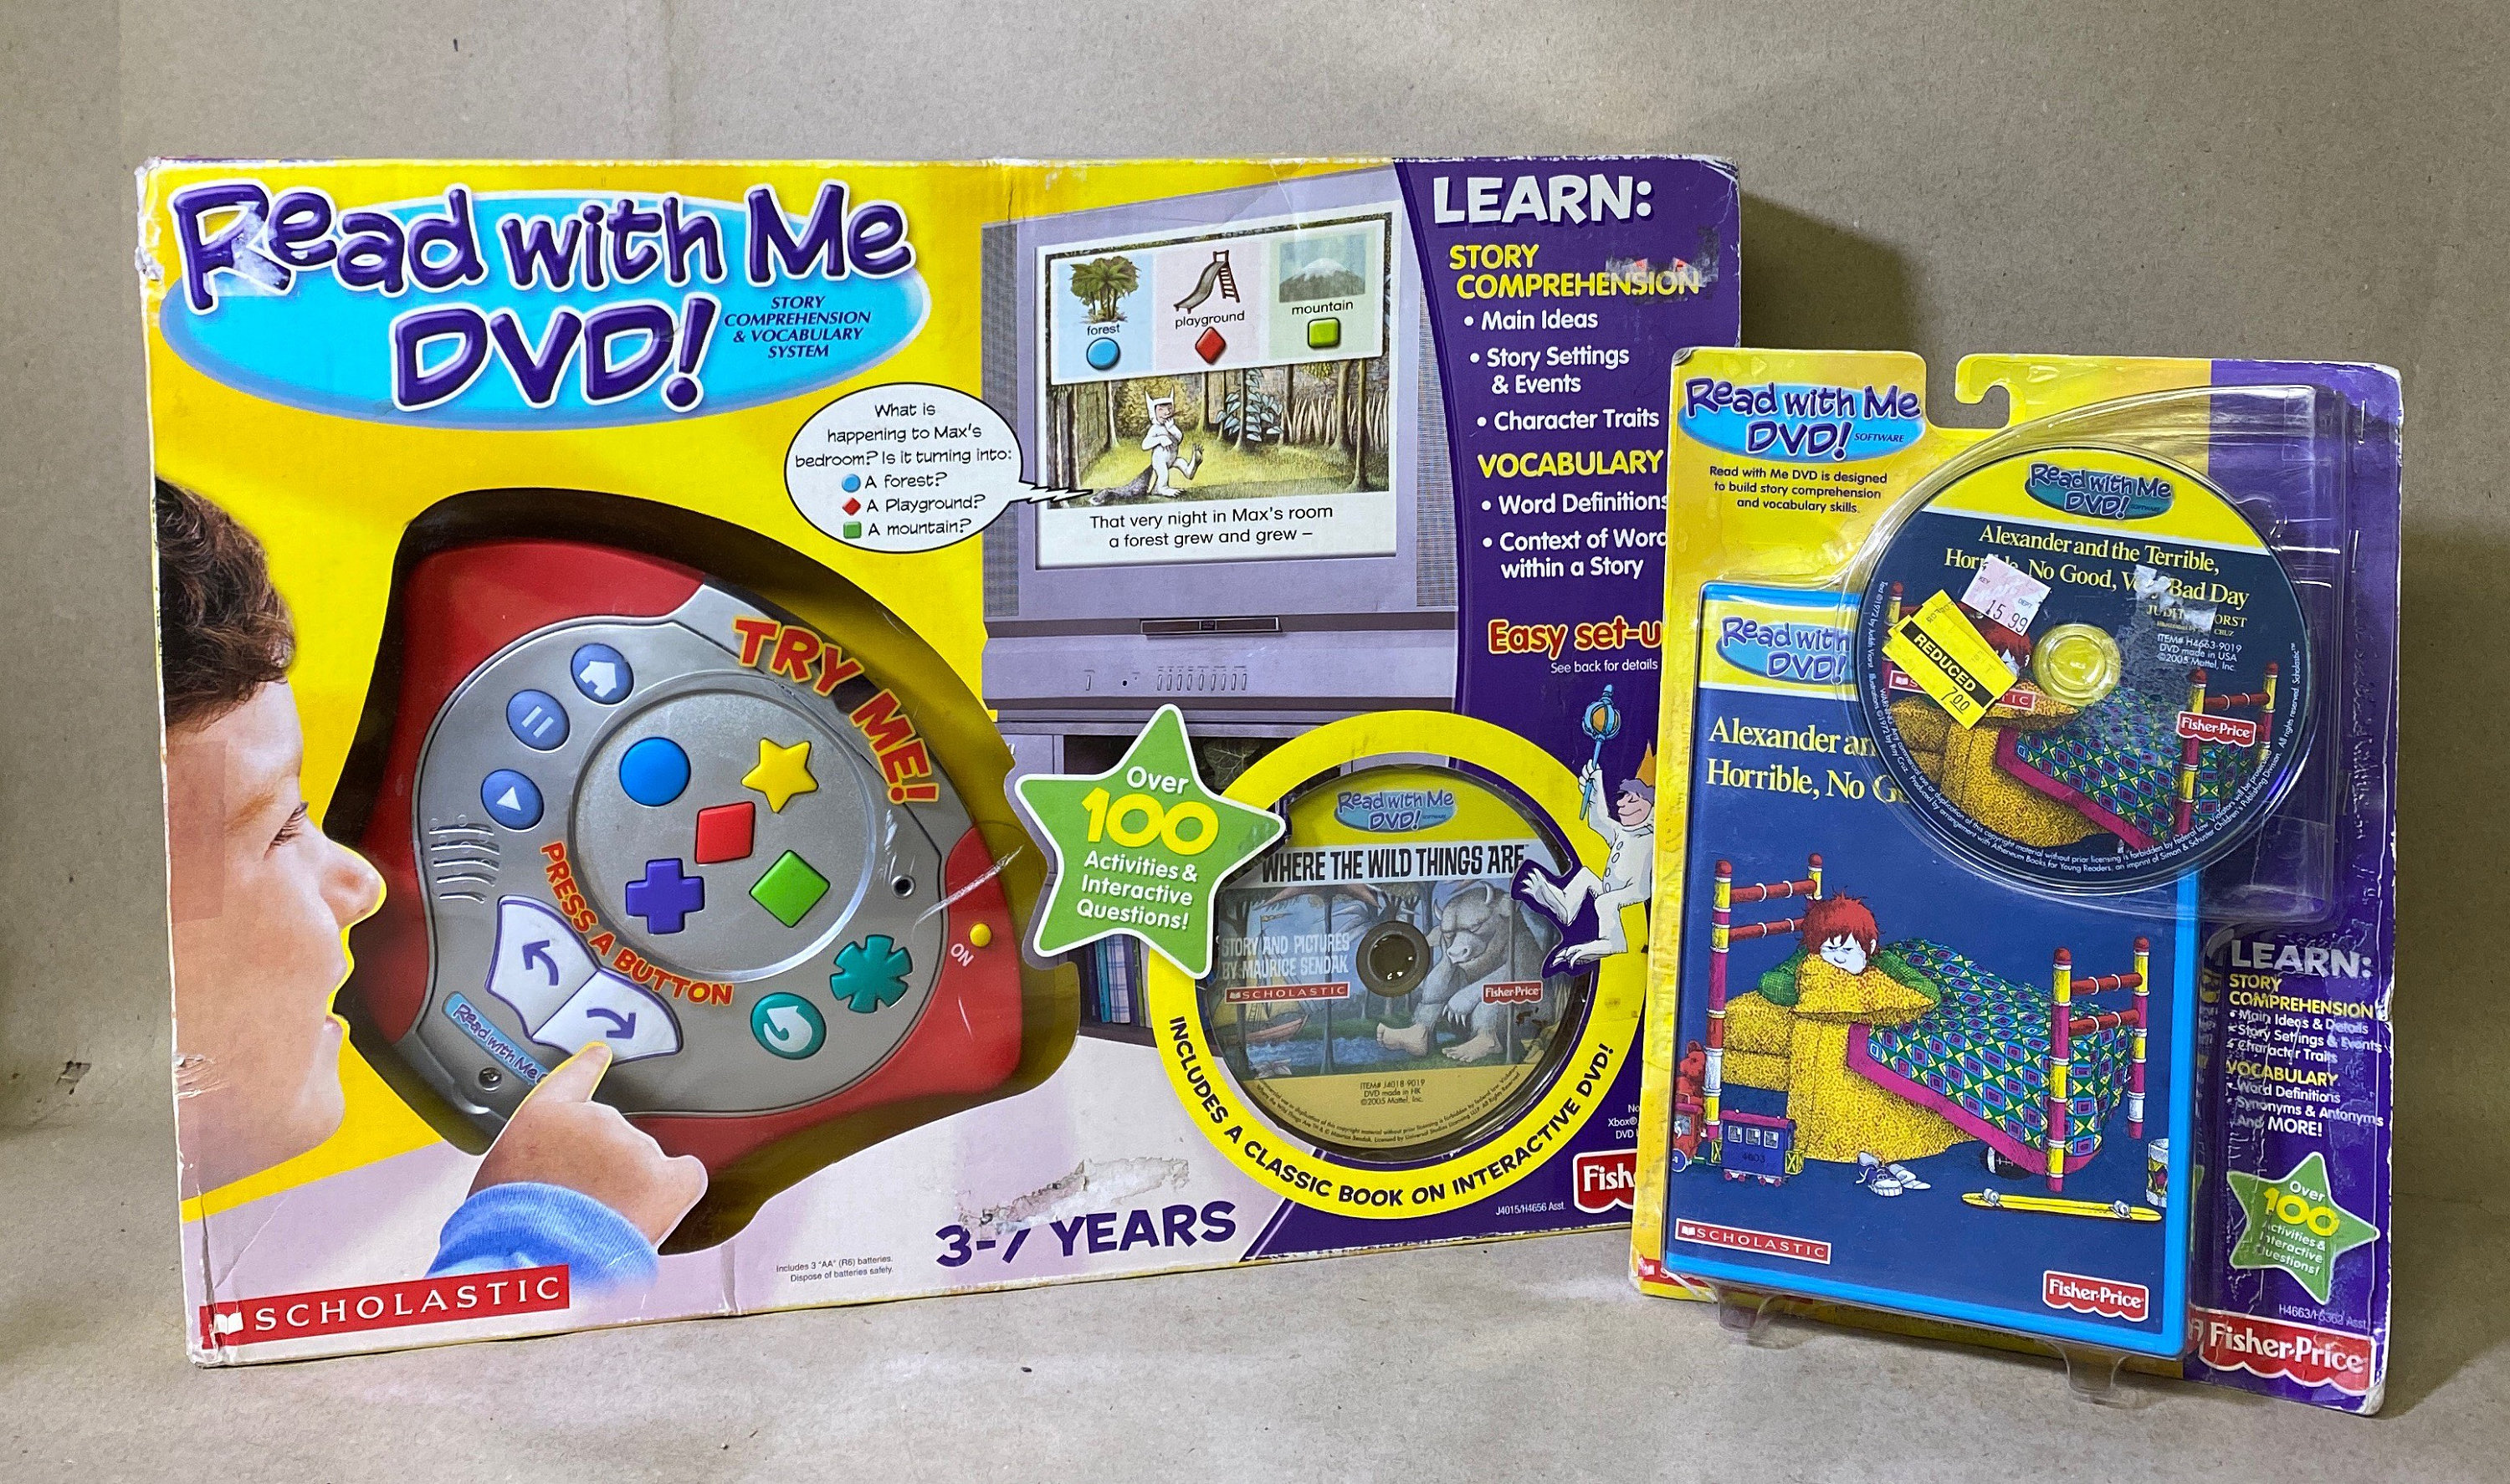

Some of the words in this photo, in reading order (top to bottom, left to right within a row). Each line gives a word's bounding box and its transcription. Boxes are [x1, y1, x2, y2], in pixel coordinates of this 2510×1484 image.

[1433, 173, 1653, 224] LEARN:
[173, 185, 483, 313] Read
[505, 197, 723, 286] with
[748, 183, 911, 282] Me
[1449, 243, 1539, 270] STORY
[1457, 271, 1699, 299] COMPREHENSION
[771, 296, 826, 310] STORY
[1291, 299, 1354, 316] mountain
[724, 311, 871, 327] COMPREHENSION
[1087, 323, 1120, 336] forest
[1175, 310, 1246, 330] playground
[1481, 310, 1534, 330] Main
[1542, 309, 1599, 330] Ideas
[733, 330, 746, 343] &
[751, 328, 863, 342] VOCABULARY
[396, 296, 717, 409] DVD!
[768, 345, 829, 358] SYSTEM
[1487, 347, 1541, 371] Story
[1546, 345, 1630, 370] Settings
[1492, 375, 1509, 395] &
[1515, 374, 1581, 393] Events
[874, 403, 917, 417] What
[923, 402, 936, 415] is
[1685, 378, 1777, 417] Read
[1785, 387, 1857, 417] with
[1863, 385, 1921, 418] Me
[1494, 409, 1597, 432] Character
[1602, 407, 1660, 428] Traits
[827, 427, 907, 445] happening
[912, 427, 930, 439] to
[935, 423, 982, 439] Max's
[1748, 422, 1852, 459] DVD!
[1854, 432, 1905, 443] SOFTWARE
[796, 450, 878, 468] bedroom?
[916, 450, 971, 466] turning
[976, 449, 1012, 462] into:
[1478, 449, 1664, 478] VOCABULARY
[884, 472, 948, 489] forest?
[1709, 467, 1739, 476] Read
[1742, 468, 1766, 478] with
[1770, 469, 1789, 479] Me
[1792, 470, 1817, 481] DVD
[1834, 472, 1888, 484] designed
[2030, 463, 2086, 488] Read
[2089, 475, 2132, 494] with
[2137, 477, 2172, 499] Me
[1498, 493, 1556, 514] Word
[1563, 491, 1667, 513] Definitions
[1729, 482, 1757, 493] build
[1760, 484, 1788, 496] story
[1791, 486, 1881, 499] comprehension
[885, 494, 986, 514] Playground?
[1737, 498, 1759, 509] and
[1763, 499, 1826, 514] vocabulary
[1830, 502, 1860, 514] skills.
[2065, 492, 2130, 519] DVD!
[868, 523, 880, 536] A
[887, 519, 972, 537] mountain?
[1089, 514, 1125, 530] That
[1130, 515, 1163, 530] very
[1168, 509, 1208, 528] night
[1212, 509, 1227, 524] in
[1232, 506, 1284, 522] Max's
[1288, 505, 1334, 520] room
[1124, 531, 1170, 548] forest
[1174, 532, 1214, 549] grew
[1219, 529, 1251, 544] and
[1256, 528, 1298, 545] grew
[1499, 530, 1581, 552] Context
[1586, 529, 1609, 549] of
[1979, 524, 2072, 555] Alexander
[2073, 539, 2108, 557] and
[2111, 544, 2140, 563] the
[2144, 545, 2220, 576] Terrible,
[1501, 557, 1564, 579] within
[1570, 560, 1585, 577] a
[1590, 556, 1644, 580] Story
[2027, 560, 2055, 581] No
[2060, 562, 2118, 592] Good,
[2169, 576, 2207, 601] Bad
[2209, 582, 2250, 611] Day
[1488, 619, 1568, 661] Easy
[1720, 617, 1791, 647] Read
[1795, 628, 1850, 652] with
[2186, 638, 2242, 652] H4663-9019
[1550, 663, 1571, 673] See
[1574, 660, 1601, 673] back
[1604, 660, 1619, 671] for
[1621, 658, 1658, 671] details
[1768, 652, 1847, 684] DVD!
[1913, 633, 1977, 693] REDUCED
[733, 617, 865, 699] TRY
[851, 688, 940, 805] ME!
[1708, 716, 1842, 754] Alexander
[2181, 718, 2251, 738] Fisher-Price
[1127, 766, 1189, 794] Over
[1706, 758, 1820, 801] Horrible,
[1825, 770, 1865, 800] No
[1337, 791, 1384, 813] Read
[1427, 789, 1454, 807] Me
[1081, 787, 1219, 855] 100
[1370, 810, 1421, 830] DVD!
[1083, 850, 1178, 880] Activities
[1181, 863, 1198, 883] &
[1262, 852, 1325, 883] WHERE
[1332, 850, 1363, 878] THE
[1367, 848, 1411, 878] WILD
[1415, 845, 1483, 876] THINGS
[1081, 874, 1193, 906] Interactive
[540, 841, 598, 933] PRESS
[589, 931, 617, 956] A
[612, 947, 734, 1006] BUTTON
[1077, 898, 1189, 930] Questions!
[951, 942, 976, 968] ON
[1222, 937, 1258, 957] STORY
[1263, 935, 1288, 954] AND
[1294, 932, 1350, 953] PICTURES
[1242, 958, 1297, 979] MAURICE
[1300, 954, 1349, 975] SENDAK
[2231, 939, 2371, 980] LEARN:
[1242, 987, 1346, 1000] SCHOLASTIC
[1484, 985, 1540, 1000] Fisher-Price
[2229, 974, 2282, 991] STORY
[2229, 991, 2374, 1019] COMPREHENSION
[453, 1003, 491, 1041] Read
[2275, 1013, 2309, 1029] Ideas
[2274, 1030, 2324, 1048] Settings
[2226, 1060, 2339, 1087] VOCABULARY
[2276, 1084, 2341, 1104] Definitions
[1169, 1016, 1228, 1126] INCLUDES
[1243, 1141, 1333, 1198] CLASSIC
[1339, 1184, 1404, 1206] BOOK
[1411, 1184, 1447, 1205] ON
[1452, 1100, 1583, 1196] INTERACTIVE
[1576, 1042, 1616, 1098] DVD!
[2318, 1107, 2384, 1127] Antonyms
[2267, 1117, 2323, 1137] MORE!
[2289, 1180, 2326, 1203] Over
[2263, 1187, 2340, 1236] 100
[1049, 1200, 1237, 1257] YEARS
[1696, 1227, 1825, 1258] SCHOLASTIC
[776, 1262, 809, 1272] Includes
[254, 1277, 560, 1332] SCHOLASTIC
[2048, 1279, 2144, 1310] Fisher-Price
[2210, 1321, 2365, 1373] Fisher-Price
